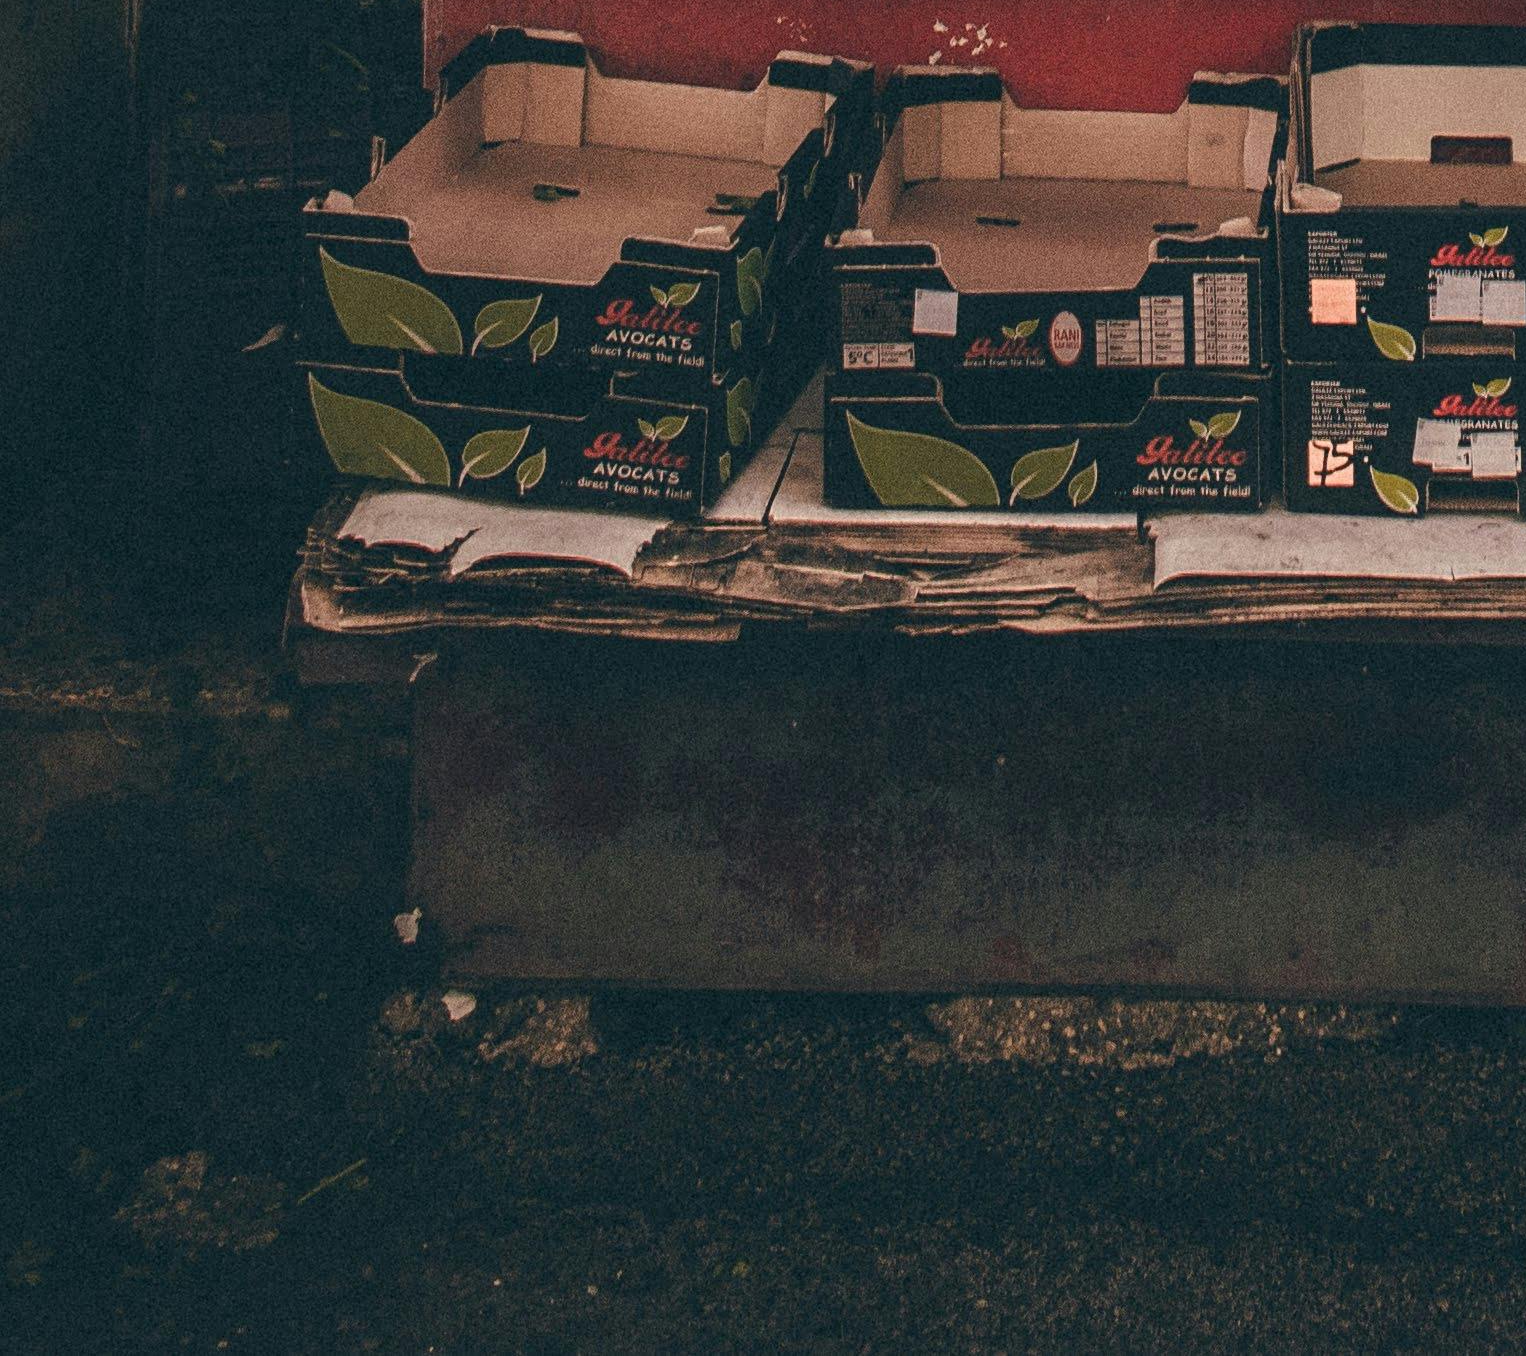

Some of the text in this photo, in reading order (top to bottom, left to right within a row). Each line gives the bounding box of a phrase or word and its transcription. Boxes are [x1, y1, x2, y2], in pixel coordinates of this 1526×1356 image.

[605, 329, 693, 351] AVOCATS
[1054, 329, 1080, 341] RANI
[593, 462, 680, 485] AVOCATS
[1147, 467, 1237, 482] AVOCATS
